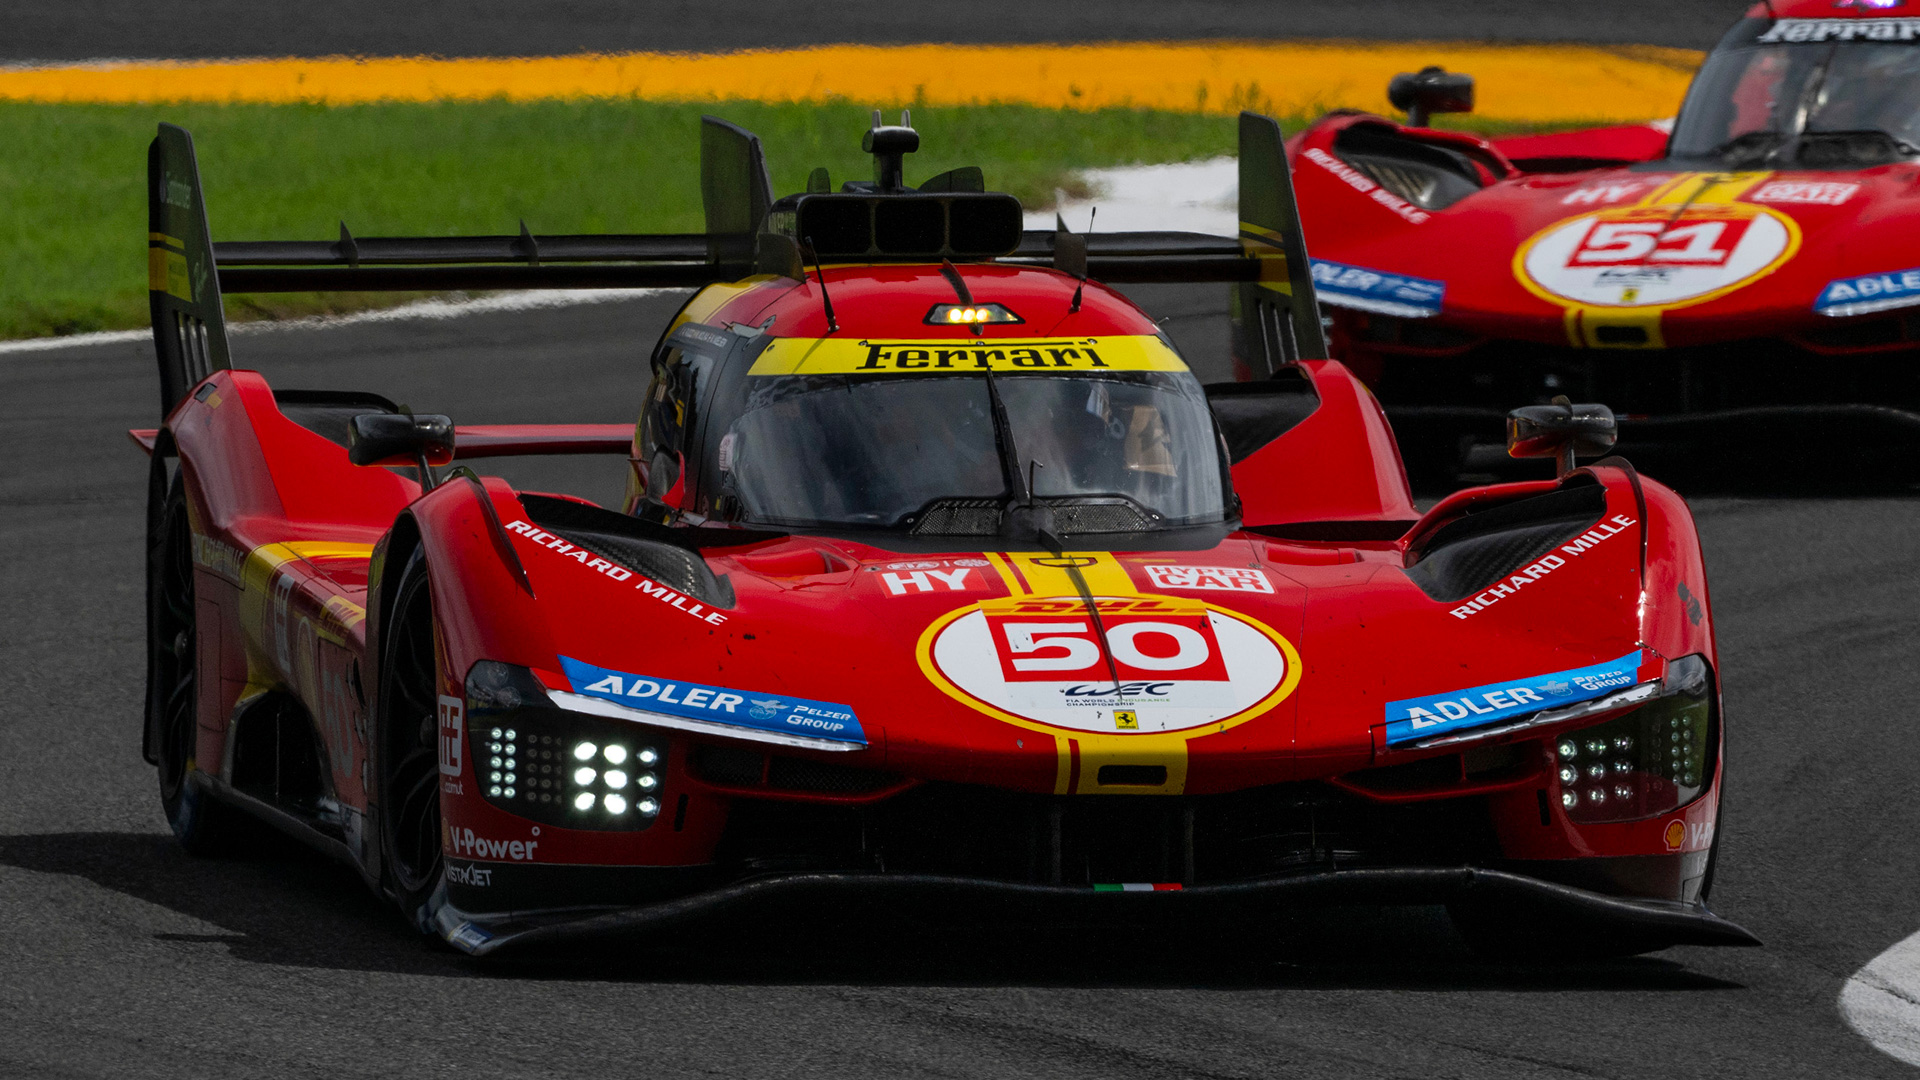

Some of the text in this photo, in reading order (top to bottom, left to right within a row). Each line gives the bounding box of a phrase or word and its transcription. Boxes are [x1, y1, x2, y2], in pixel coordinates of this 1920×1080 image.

[1576, 222, 1728, 262] 51
[856, 341, 1109, 370] Ferrari
[504, 520, 728, 626] RICHARD MILLE
[881, 568, 971, 595] HY
[1151, 567, 1259, 578] HYPER
[1158, 574, 1266, 591] CAR
[1449, 514, 1637, 620] RICHARD MILLE
[1014, 601, 1176, 613] DHL
[1002, 621, 1209, 672] 50
[583, 674, 744, 714] ADLER
[1065, 682, 1175, 697] WEC
[1406, 686, 1545, 730] ADLER
[450, 826, 538, 860] V-Power
